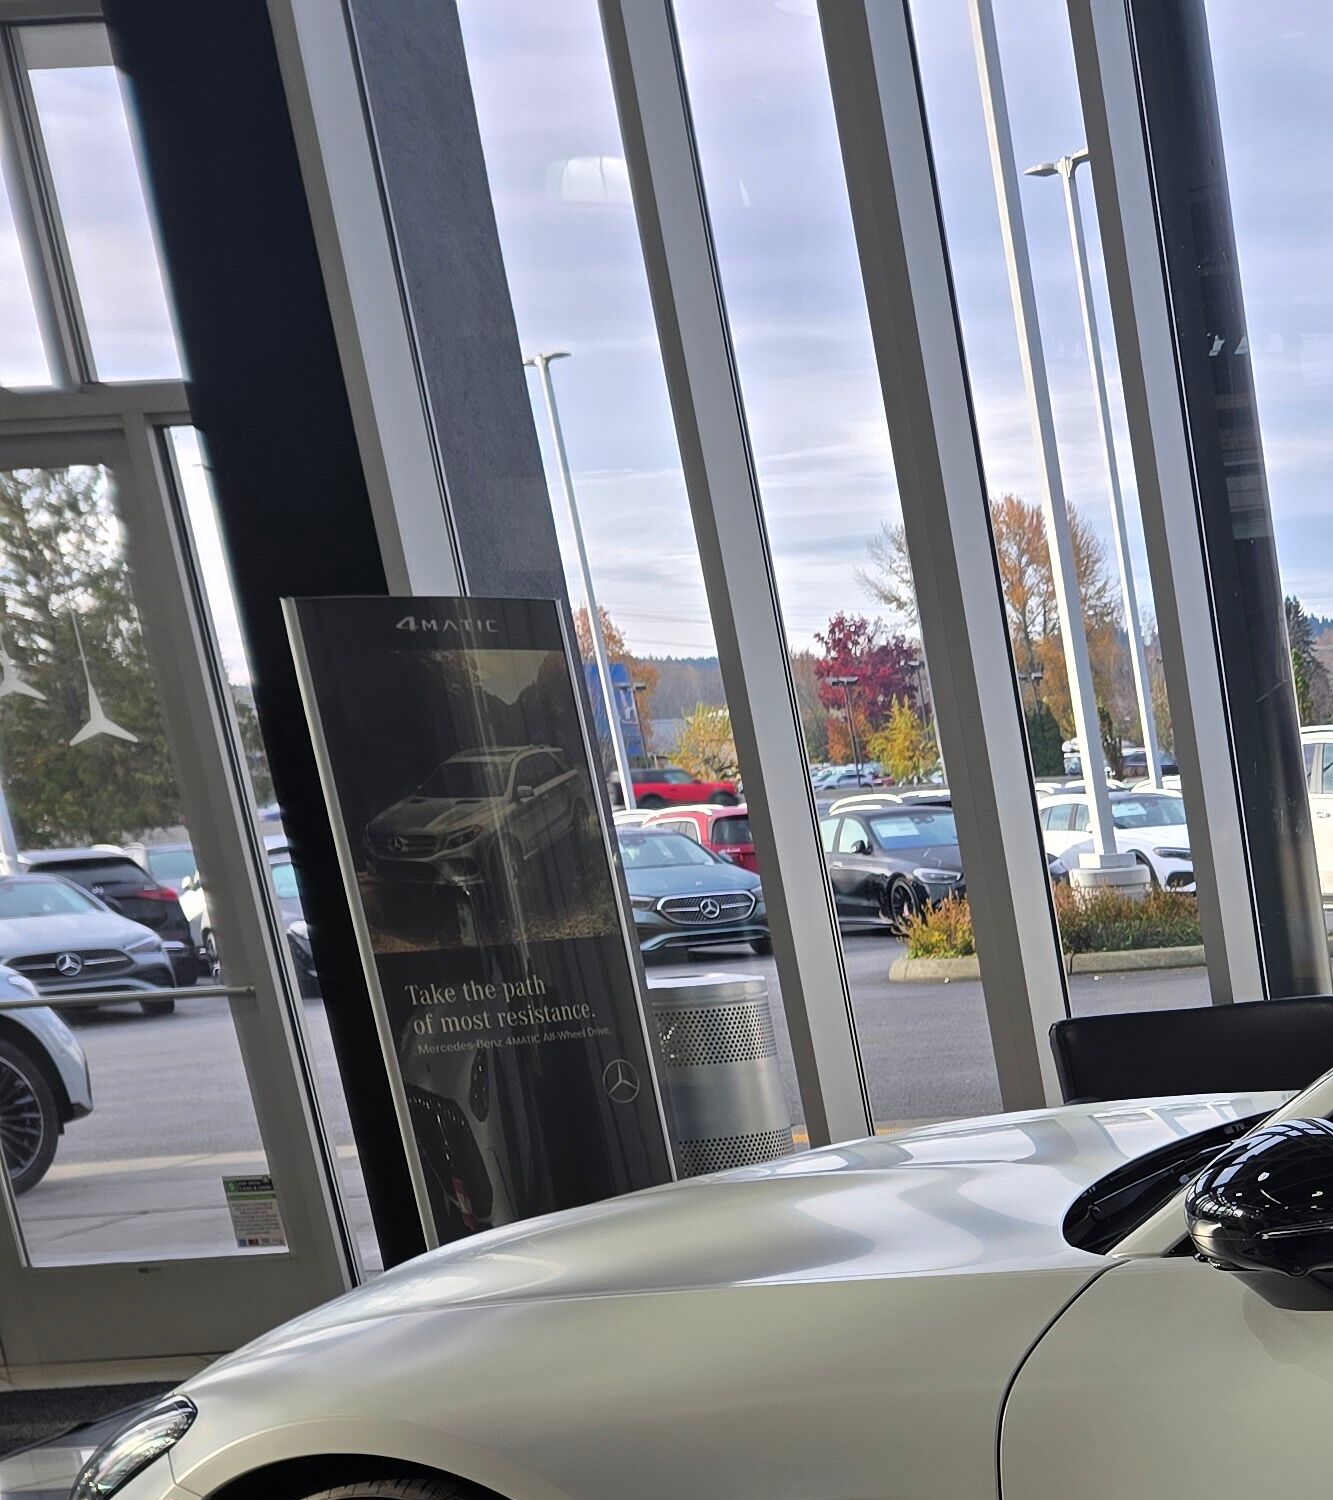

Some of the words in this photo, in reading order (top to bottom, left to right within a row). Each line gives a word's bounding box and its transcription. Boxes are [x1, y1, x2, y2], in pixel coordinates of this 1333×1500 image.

[395, 616, 499, 632] 4MATIC
[405, 984, 456, 1006] Take
[462, 980, 497, 1001] the
[502, 975, 546, 1002] path
[413, 1013, 434, 1036] of
[441, 1010, 492, 1033] most
[497, 1003, 596, 1028] resistance.
[418, 1038, 503, 1055] Mercedes-Benz
